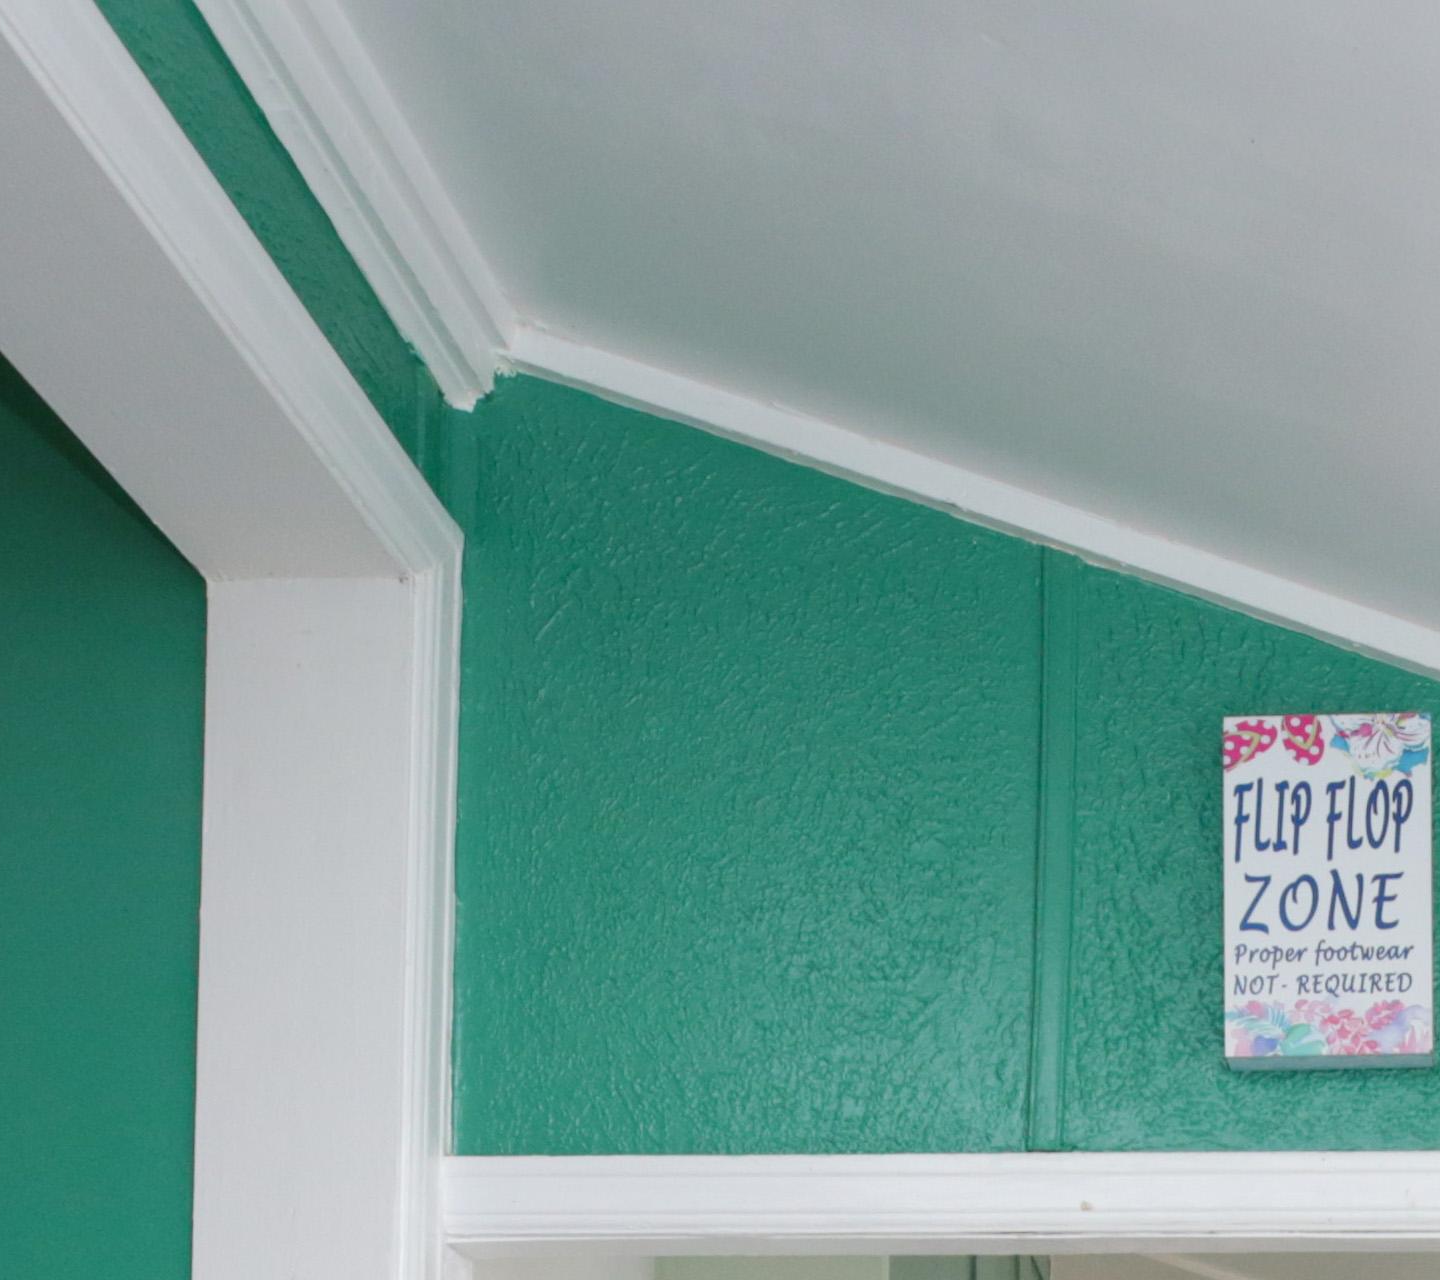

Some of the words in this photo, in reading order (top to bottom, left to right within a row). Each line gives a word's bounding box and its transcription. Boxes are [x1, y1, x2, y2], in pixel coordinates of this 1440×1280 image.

[1233, 777, 1312, 863] FLIP
[1326, 775, 1414, 862] FLOP
[1239, 869, 1404, 935] ZONE
[1234, 943, 1307, 970] Proper
[1315, 939, 1415, 965] footwear
[1297, 973, 1413, 998] REQUIRED
